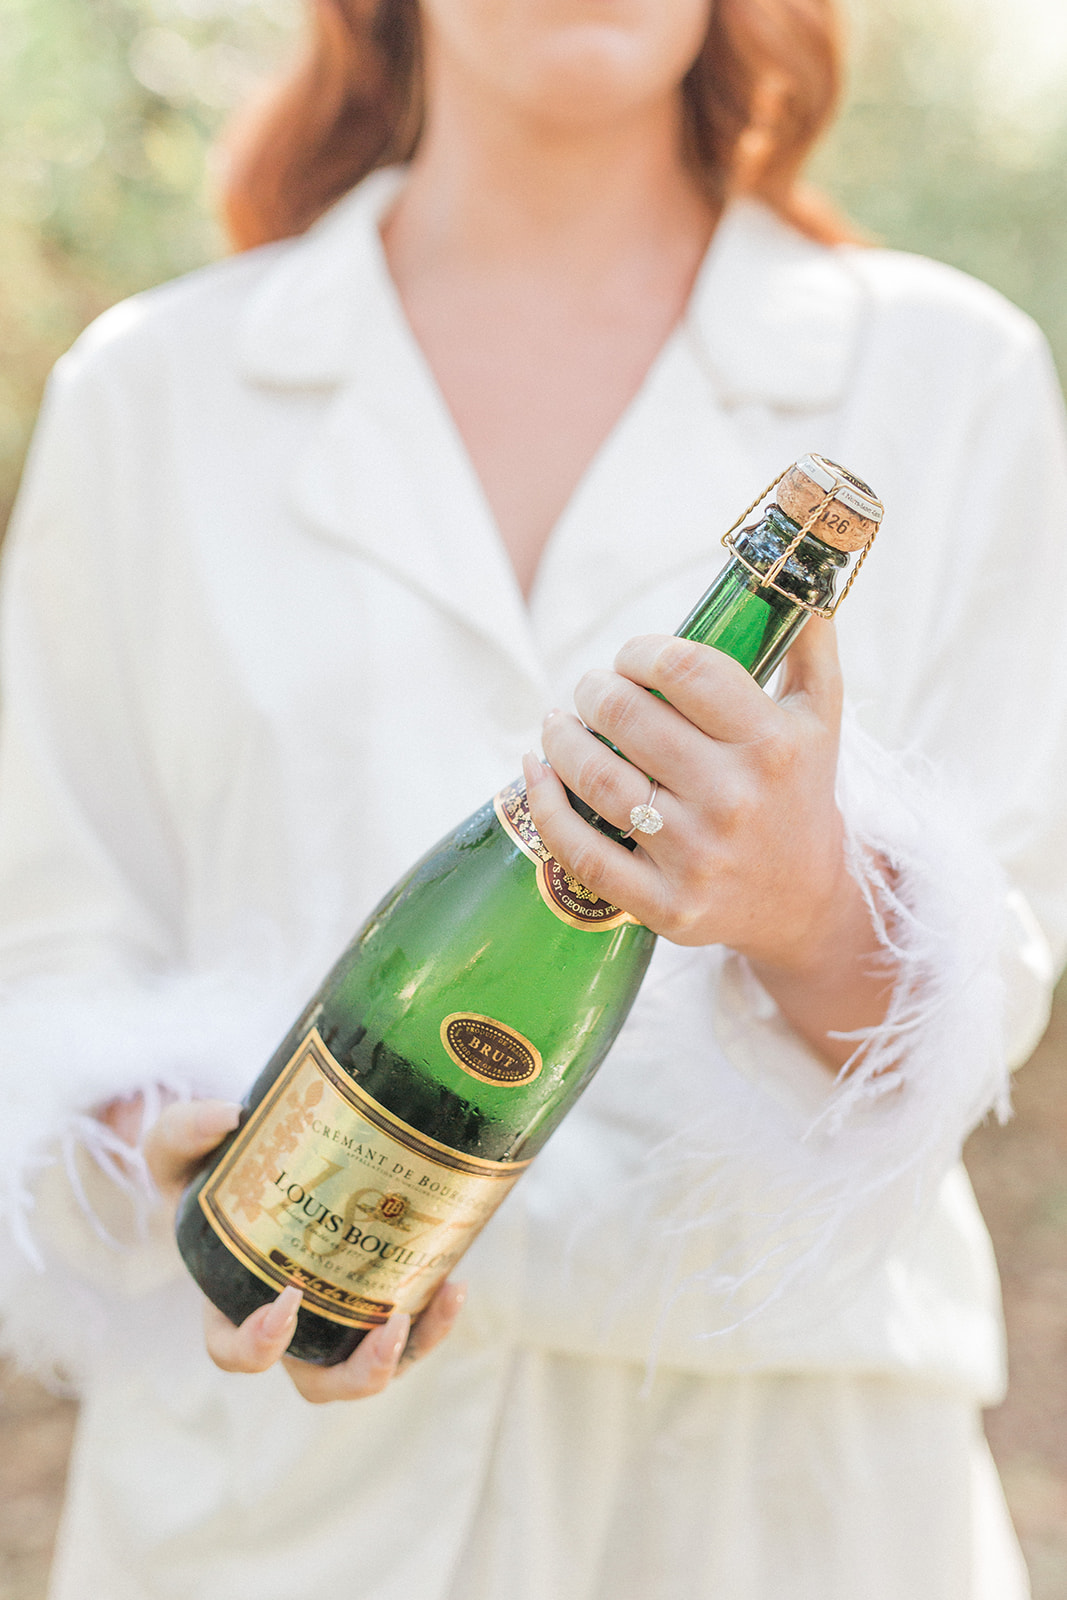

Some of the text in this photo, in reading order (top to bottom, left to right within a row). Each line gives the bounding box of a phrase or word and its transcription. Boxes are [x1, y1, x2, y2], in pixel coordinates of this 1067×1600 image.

[561, 894, 604, 917] GEORGES
[468, 1036, 516, 1068] BRUT
[311, 1119, 389, 1166] CRÉMANT
[392, 1163, 413, 1179] DE
[274, 1169, 344, 1233] LOUIS
